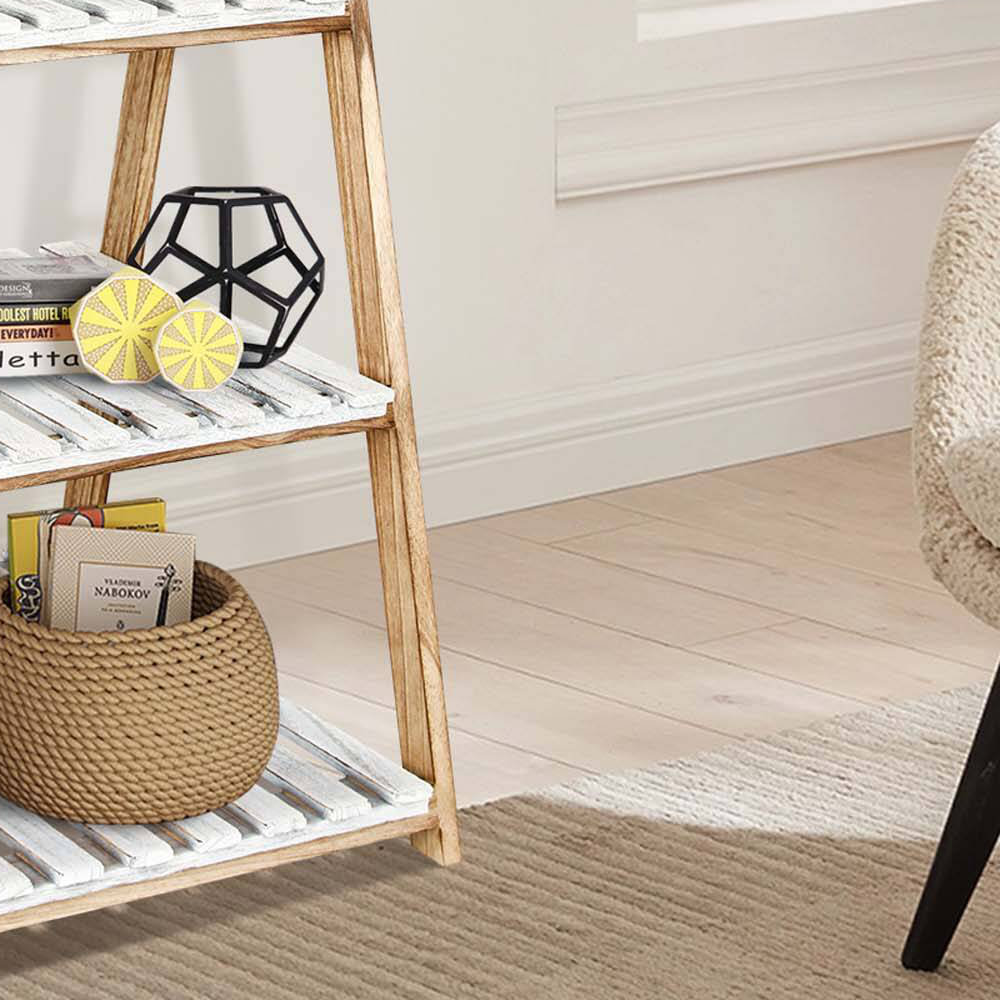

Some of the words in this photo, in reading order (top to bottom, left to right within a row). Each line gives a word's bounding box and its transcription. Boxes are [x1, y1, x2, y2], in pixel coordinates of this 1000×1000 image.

[32, 306, 60, 321] HOTEL
[1, 327, 54, 340] EVERYDAY!
[94, 586, 151, 599] NABOKOV
